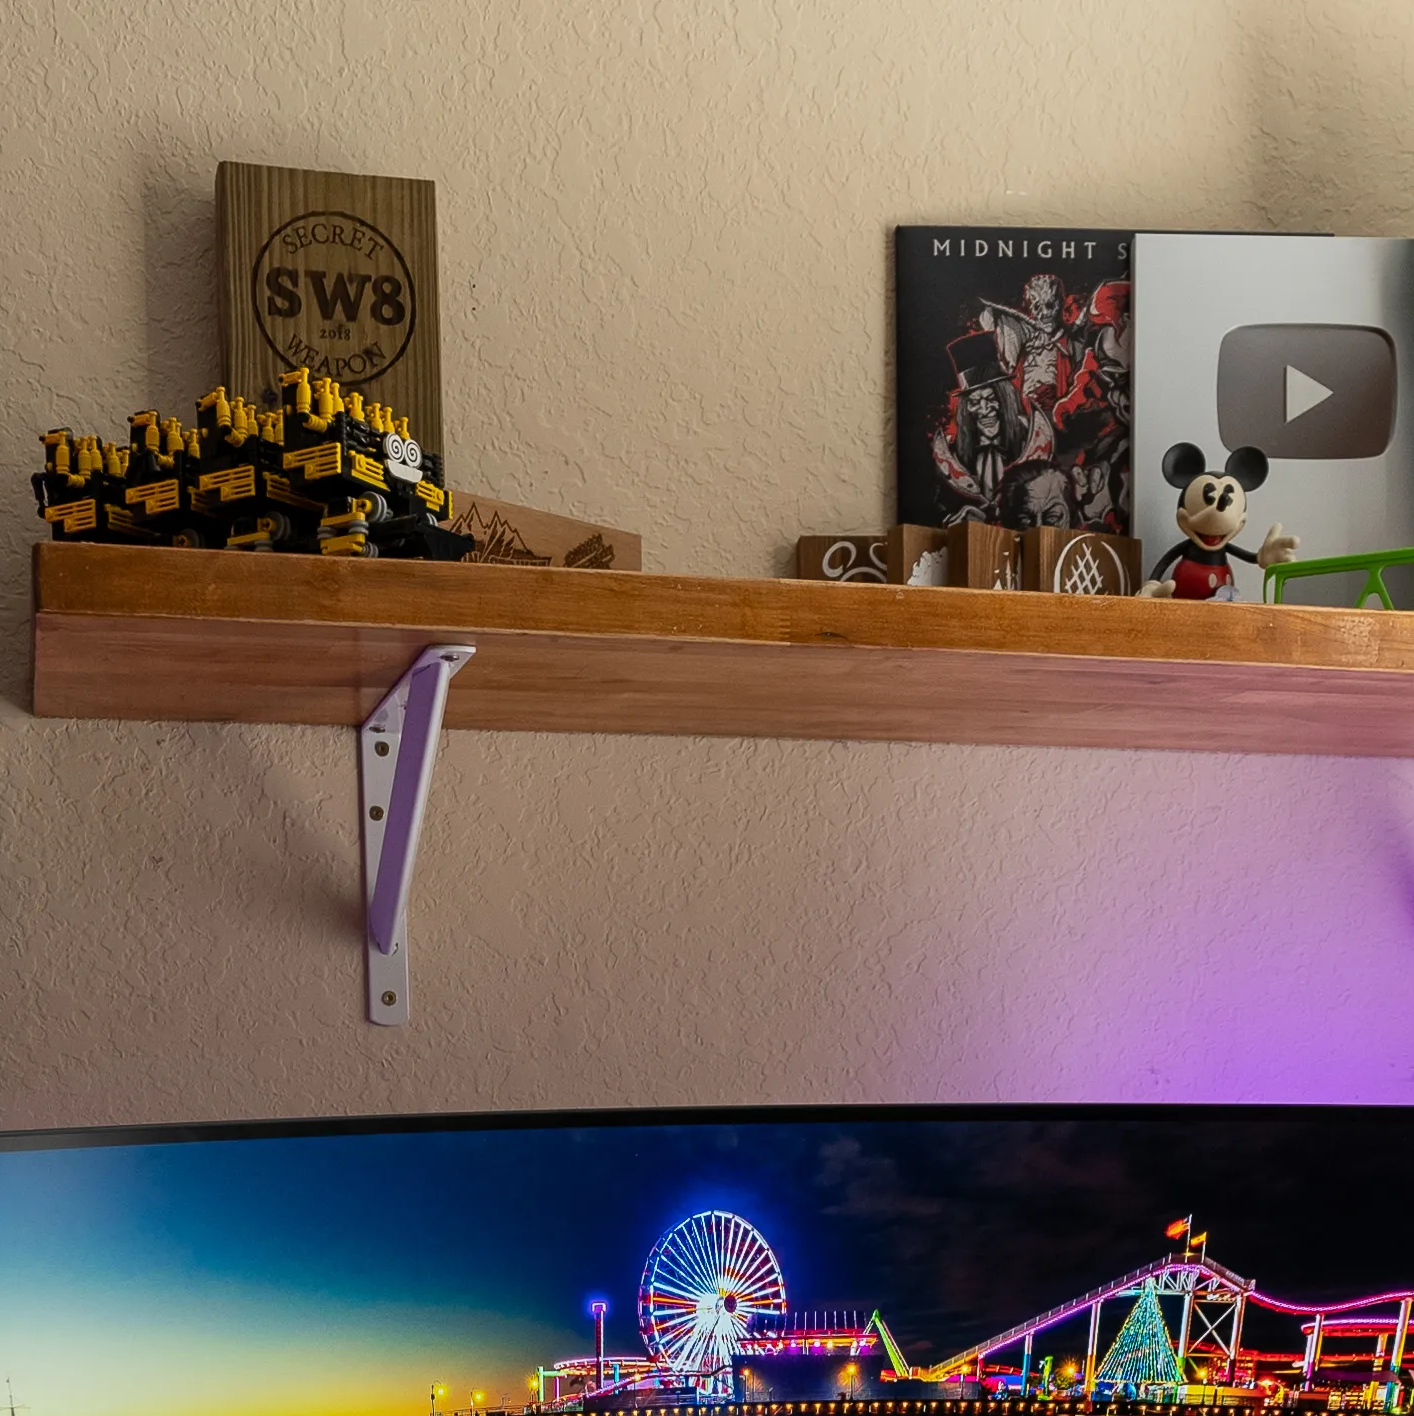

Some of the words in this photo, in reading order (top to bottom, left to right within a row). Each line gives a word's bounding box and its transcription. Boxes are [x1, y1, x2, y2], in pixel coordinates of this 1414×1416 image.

[282, 223, 384, 260] SECRET
[933, 239, 1097, 259] MIDNIGHT
[1117, 243, 1128, 260] S
[266, 266, 405, 326] SW8
[320, 329, 351, 341] 2018
[287, 334, 387, 377] WEAPON
